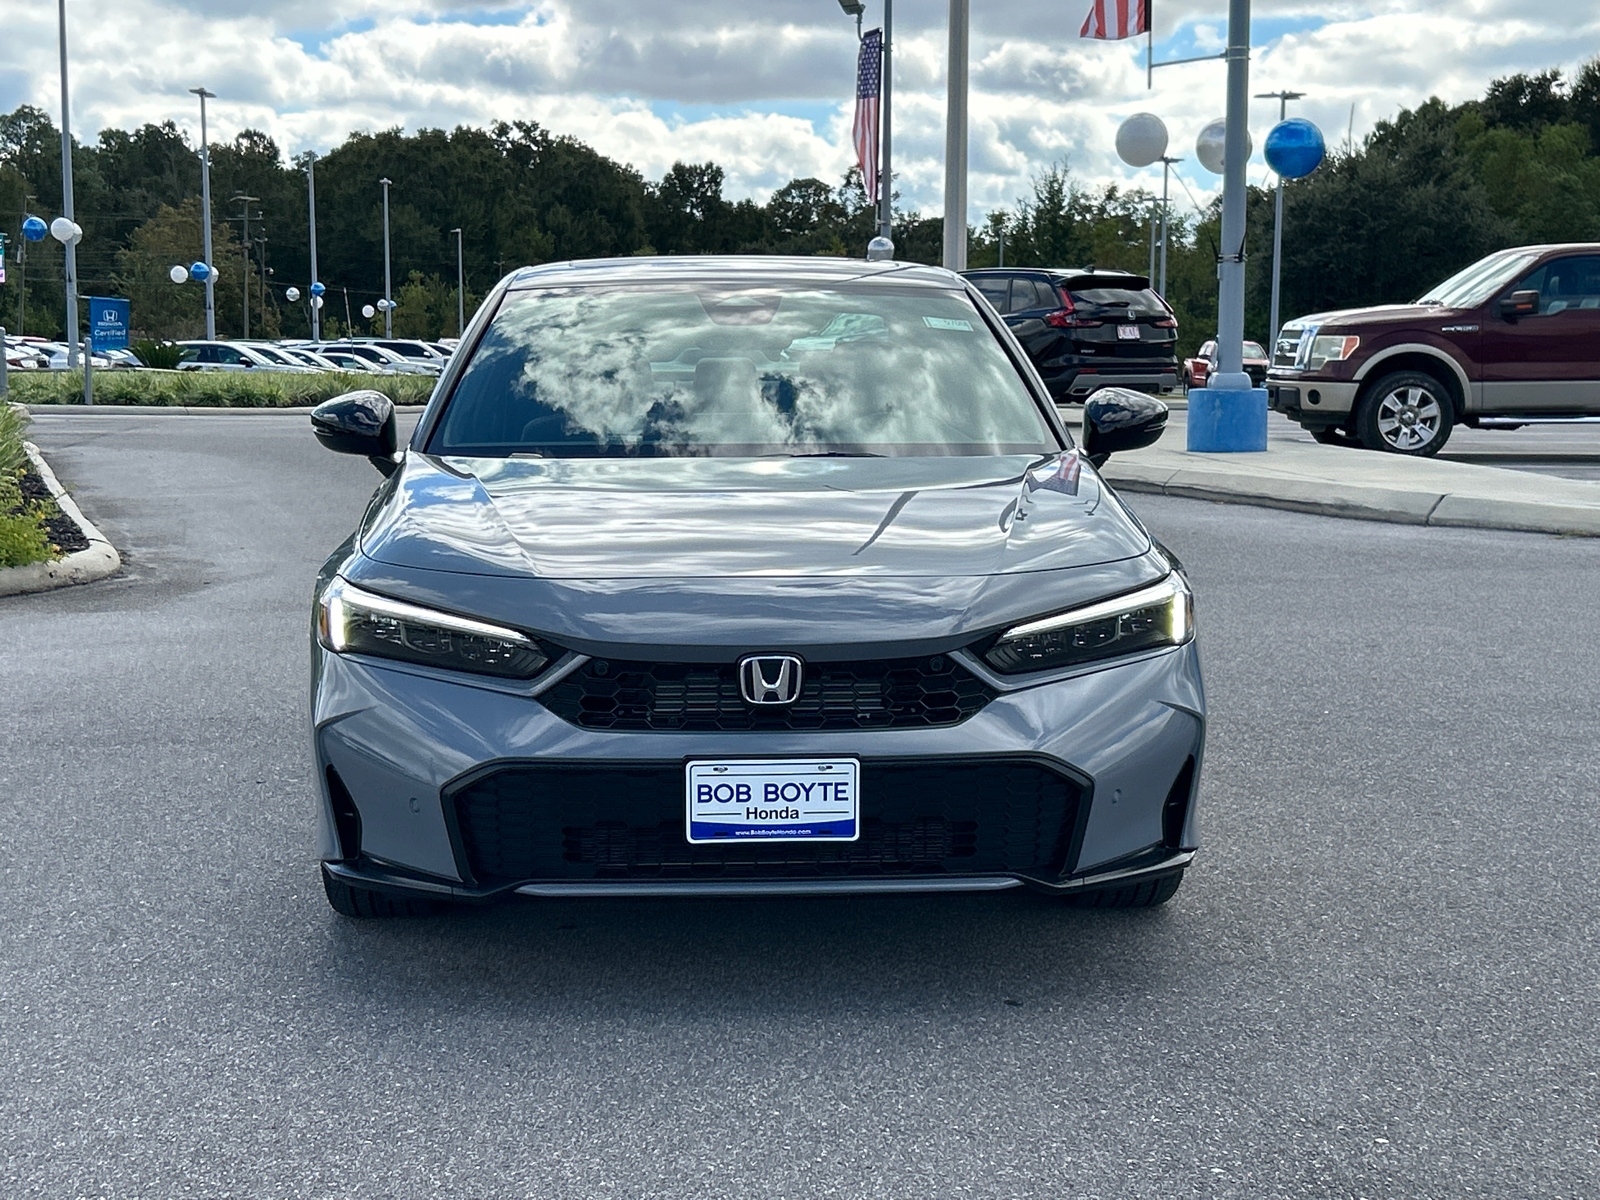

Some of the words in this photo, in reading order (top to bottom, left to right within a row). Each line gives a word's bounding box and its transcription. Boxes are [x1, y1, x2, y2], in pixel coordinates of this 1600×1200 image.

[697, 783, 752, 804] BOB
[763, 782, 849, 803] BOYTE
[746, 806, 800, 820] Honda
